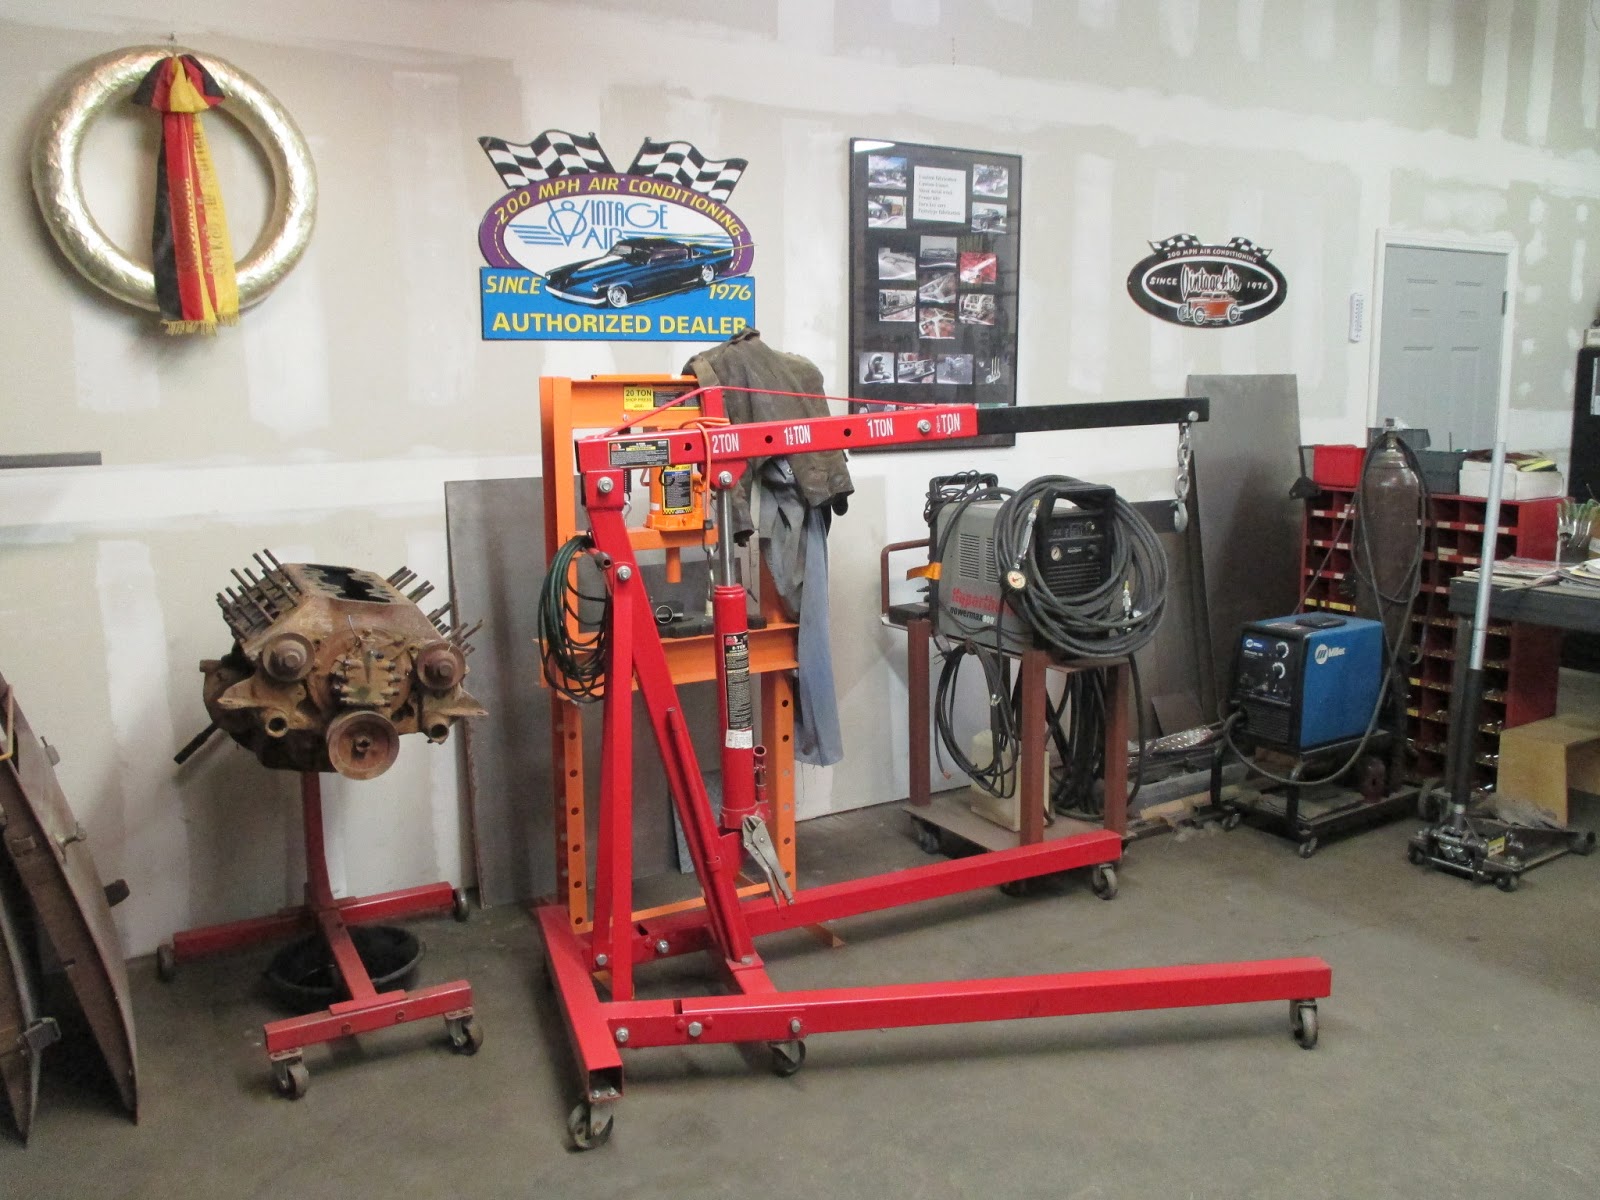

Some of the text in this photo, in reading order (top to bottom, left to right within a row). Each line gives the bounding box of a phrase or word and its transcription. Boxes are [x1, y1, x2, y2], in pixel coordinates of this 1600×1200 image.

[494, 177, 743, 236] 200 MPH AIR CONDITIONING
[547, 200, 668, 246] VINTAGE
[582, 227, 628, 250] AIR
[1167, 251, 1181, 259] 200
[1183, 248, 1198, 256] MPH
[1212, 249, 1258, 264] CONDITIONING
[485, 275, 752, 301] SINCE 1976
[1149, 276, 1268, 290] SINCE 1976
[492, 312, 747, 336] AUTHORIZED DEALER
[625, 389, 652, 397] 20 TON
